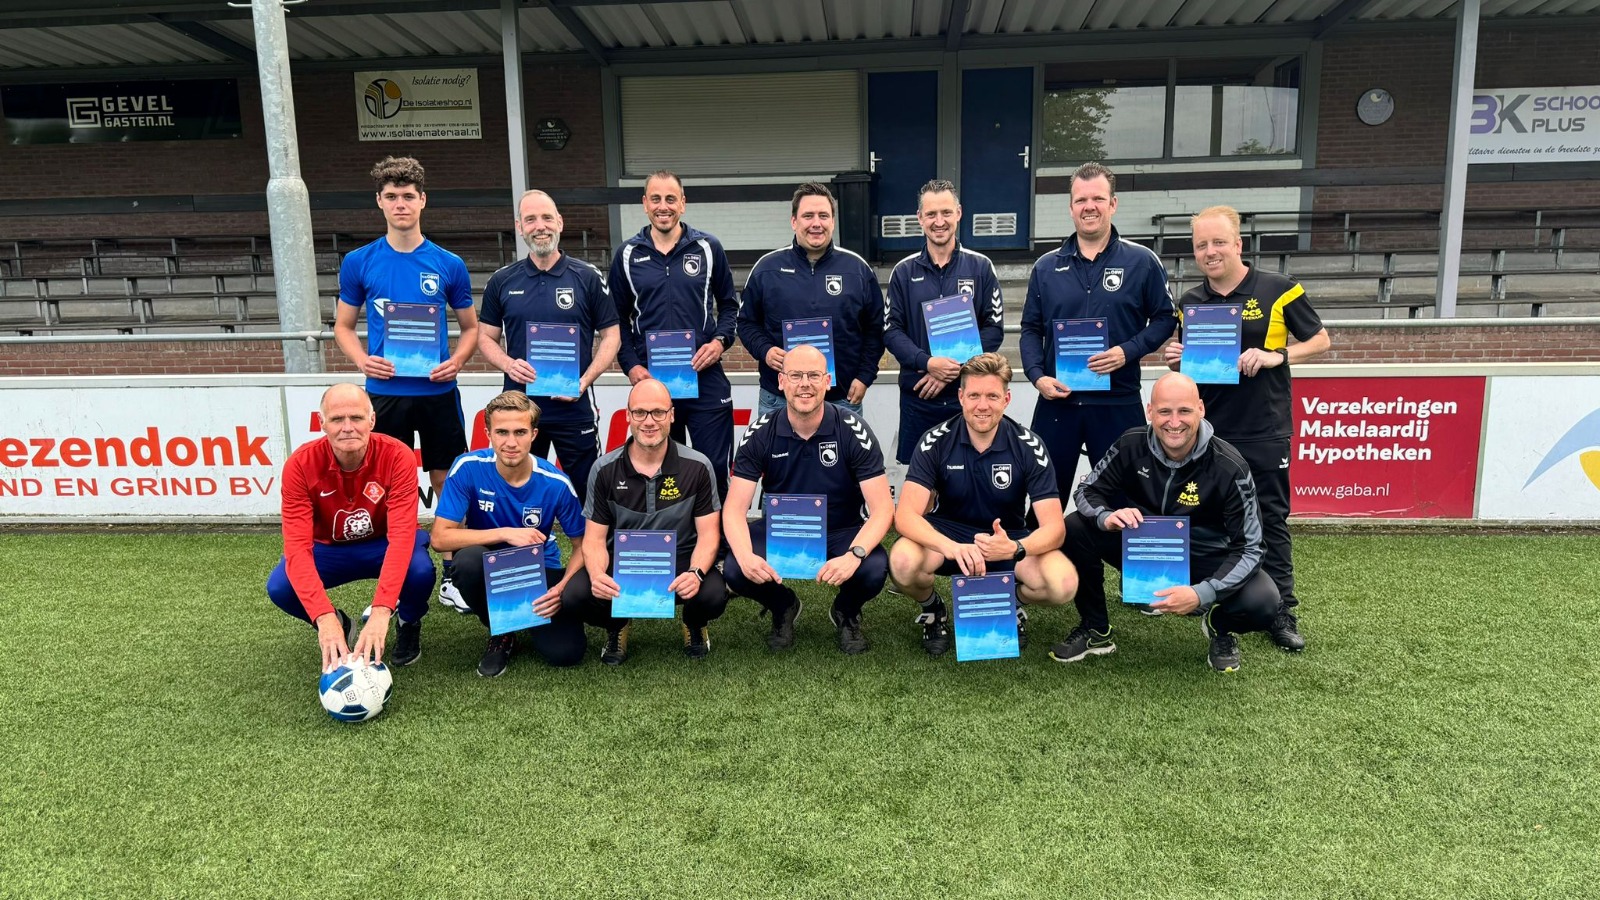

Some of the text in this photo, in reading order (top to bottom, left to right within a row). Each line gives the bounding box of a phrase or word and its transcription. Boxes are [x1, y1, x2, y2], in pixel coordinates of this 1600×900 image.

[412, 74, 472, 88] Isolatie nodig?
[102, 95, 173, 112] GEVEL
[104, 116, 175, 128] GASTEN.NL
[1531, 117, 1586, 133] PLUS
[361, 128, 480, 138] www.isolatiemateriaal.nl
[1497, 146, 1531, 155] diensten
[1544, 145, 1556, 154] de
[1557, 144, 1591, 153] breedste
[1301, 396, 1458, 419] Verzekeringen
[1300, 419, 1430, 441] Makelaardij
[0, 425, 273, 468] ezendonk
[1298, 443, 1432, 464] Hypotheken
[54, 477, 99, 497] EN
[110, 477, 218, 497] GRIND
[229, 476, 275, 496] BV
[660, 487, 680, 496] DCS
[1294, 482, 1390, 499] www.gaba.nl
[1179, 491, 1199, 502] DCS
